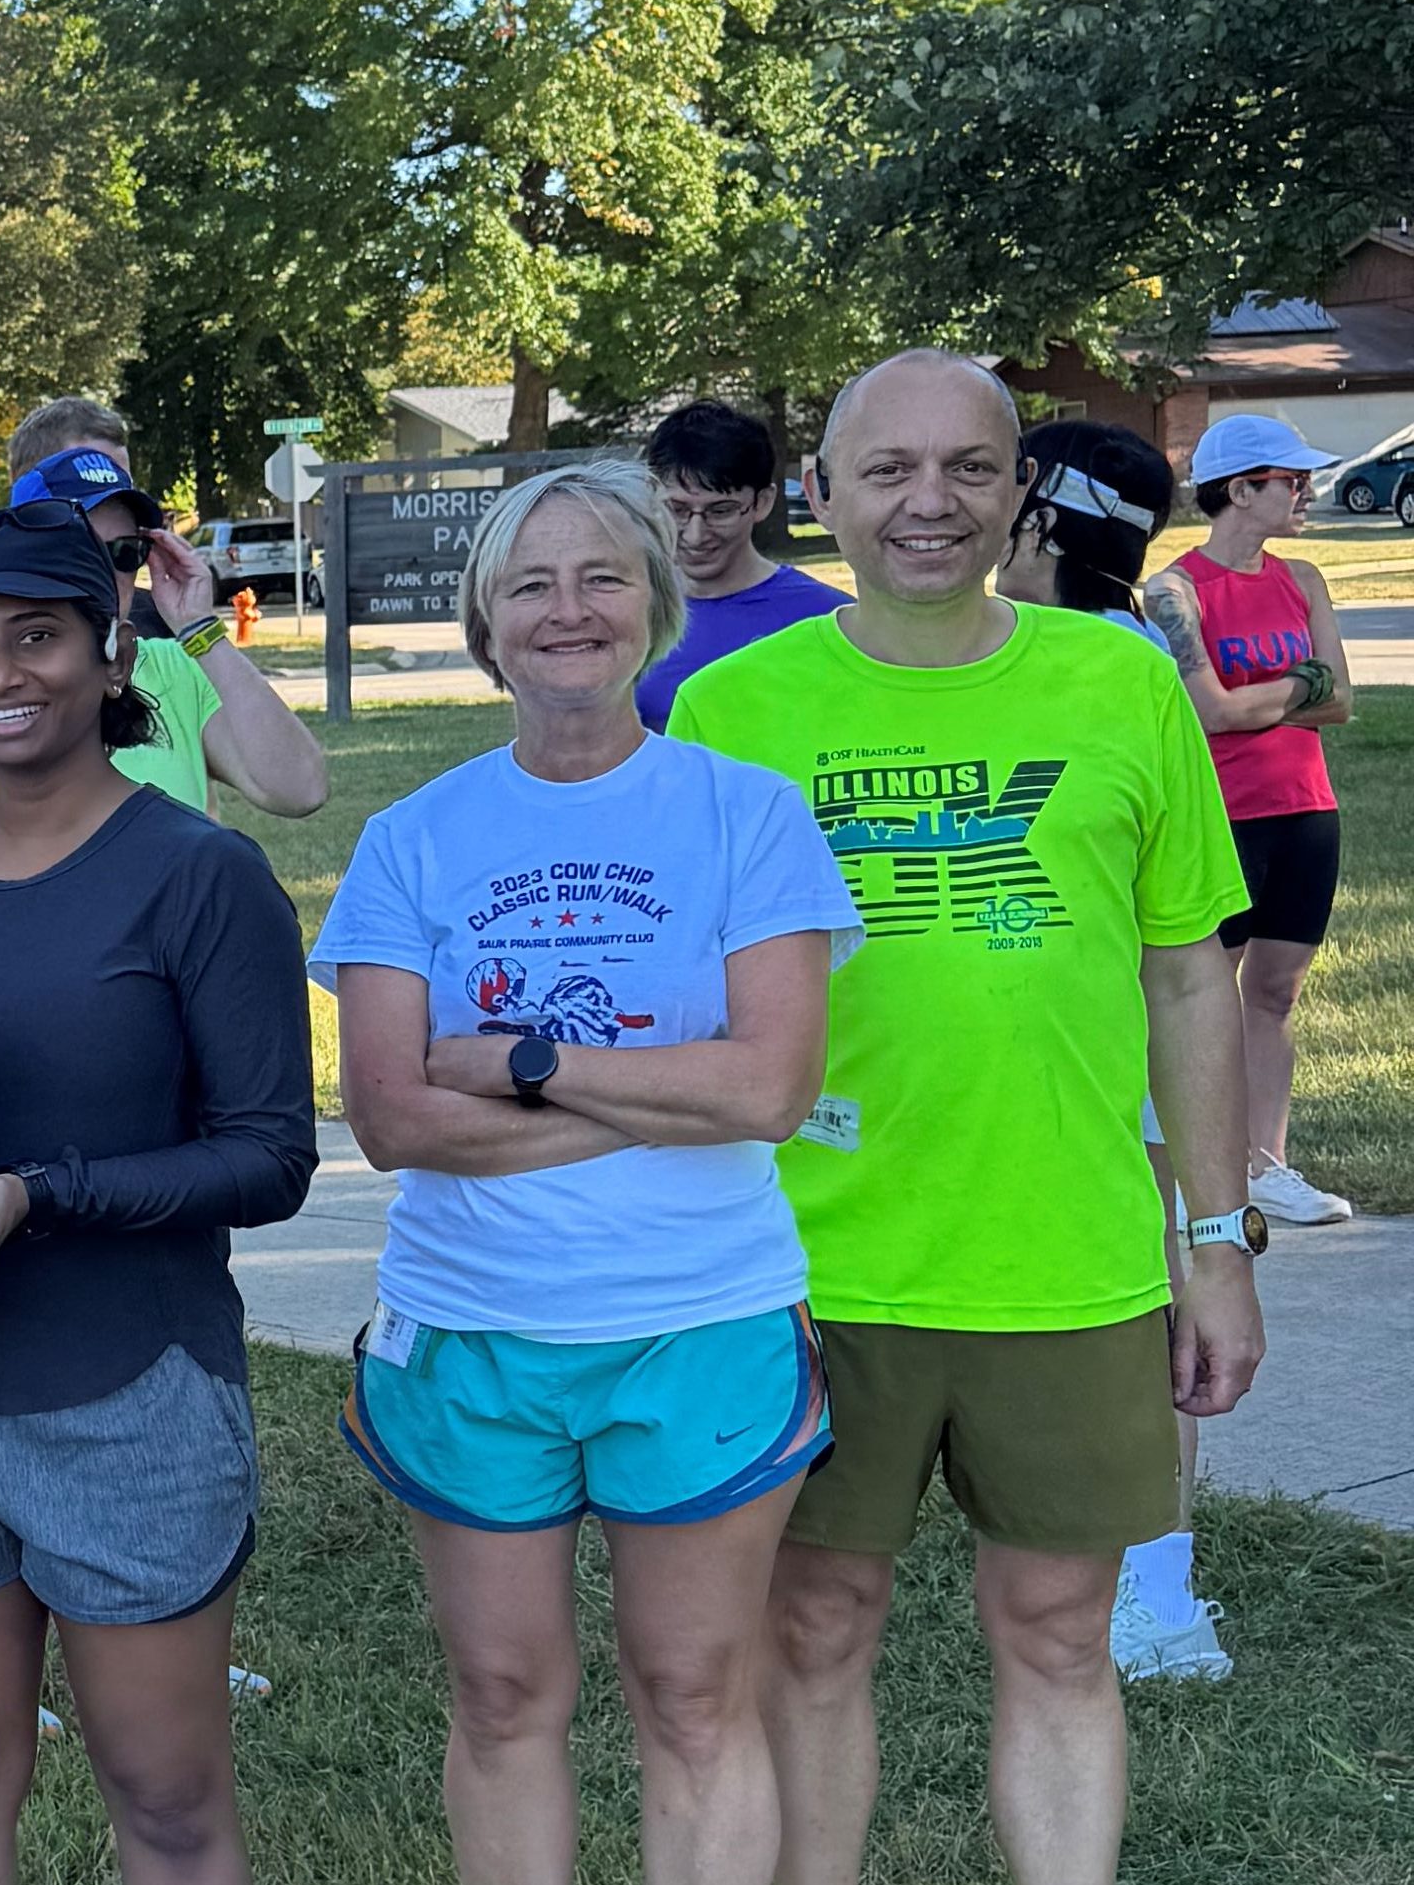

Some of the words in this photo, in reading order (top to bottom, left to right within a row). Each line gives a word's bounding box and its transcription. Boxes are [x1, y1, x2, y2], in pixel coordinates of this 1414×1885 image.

[392, 490, 498, 520] MORRIS
[383, 572, 422, 588] PARK
[370, 596, 413, 612] DAWN
[421, 595, 440, 611] TO
[1217, 629, 1311, 675] RUN
[818, 765, 980, 804] ILLINOIS
[490, 869, 543, 896] 2023
[550, 863, 601, 879] COW
[604, 863, 655, 886] CHIP
[467, 886, 550, 932] CLASSIC
[557, 884, 674, 924] RUN/WALK
[554, 934, 624, 948] COMMUNITY
